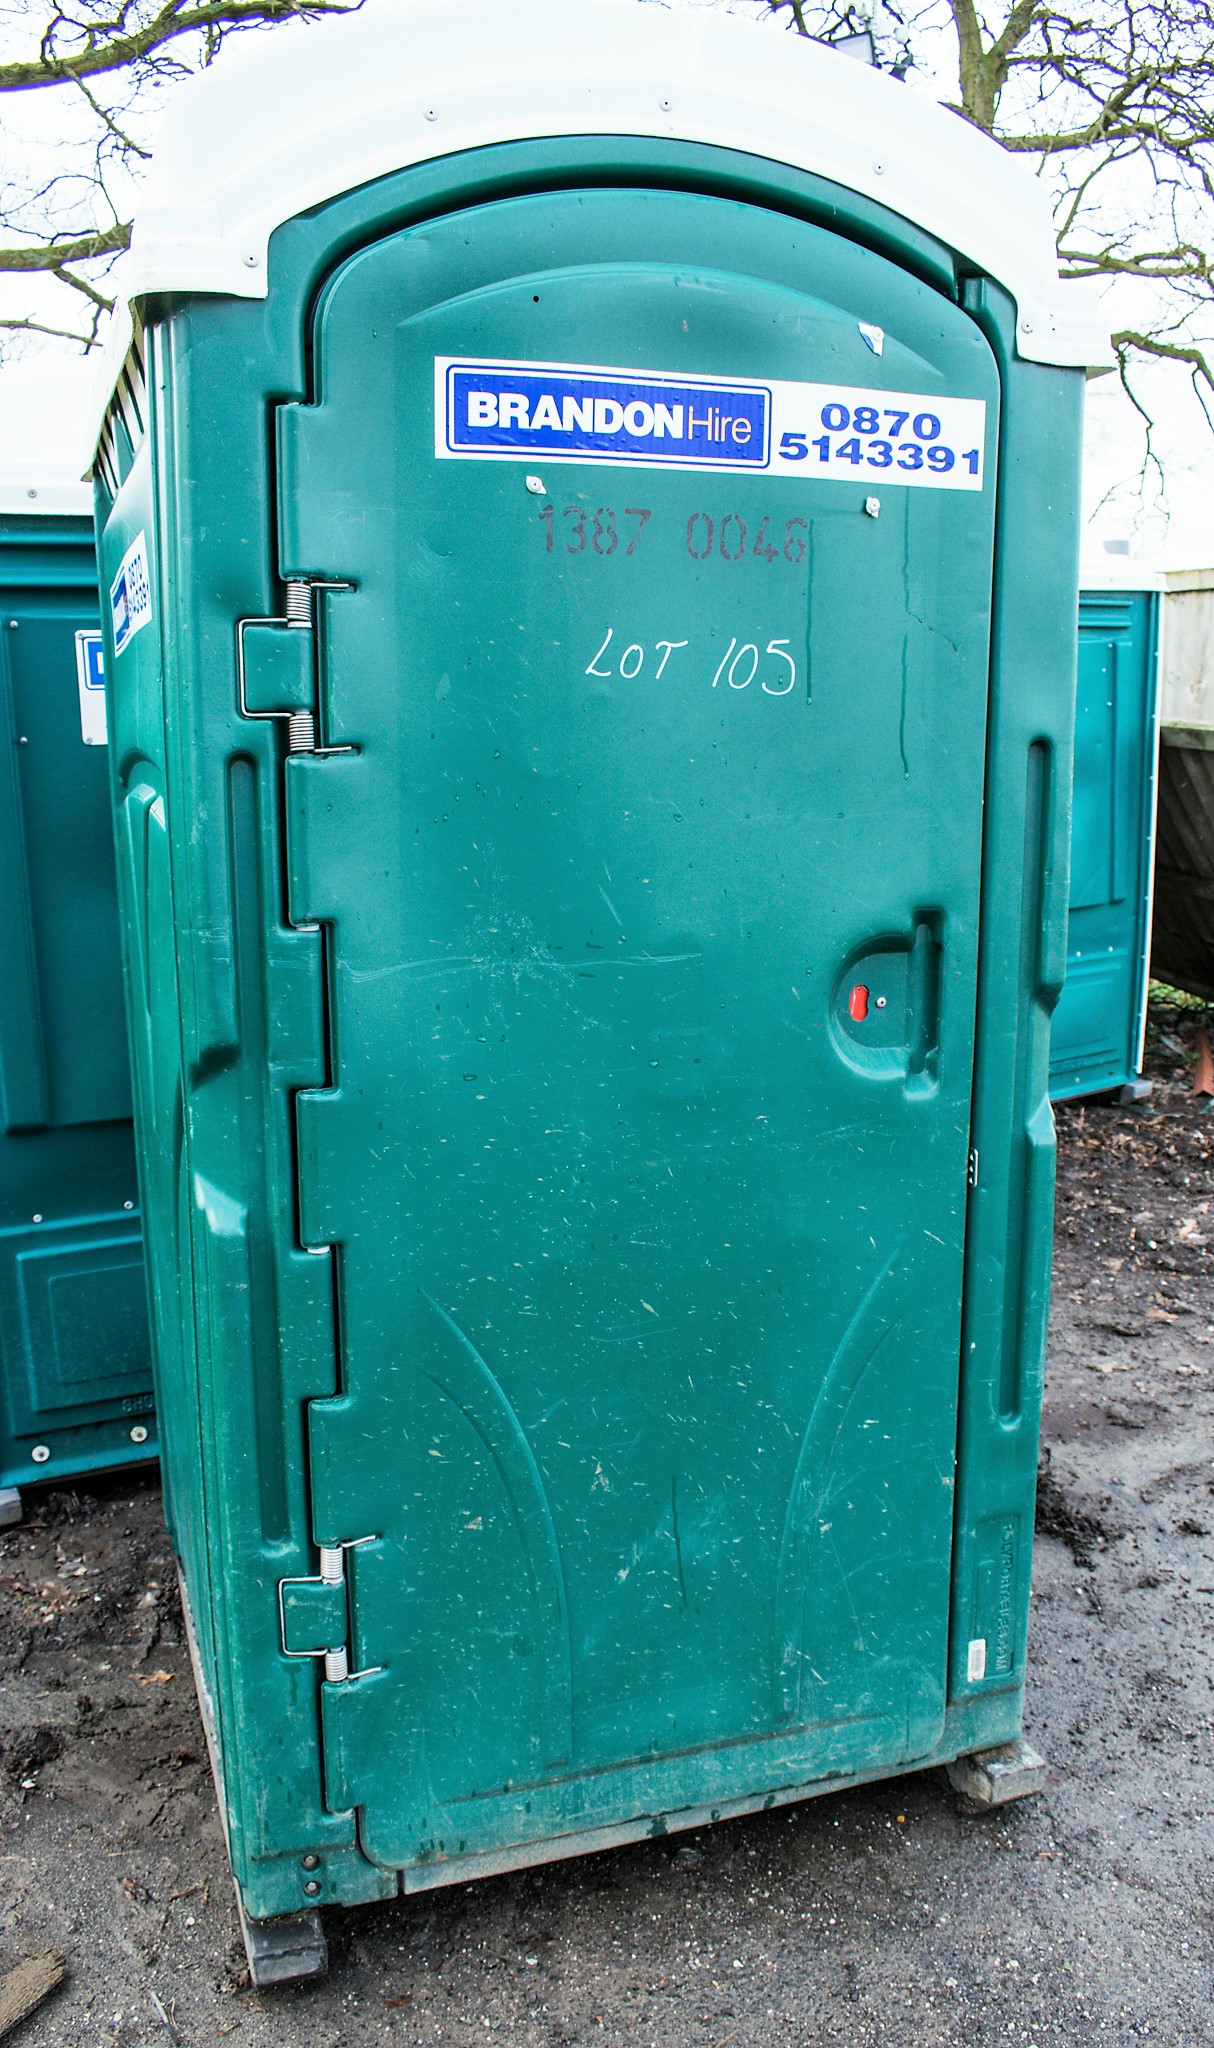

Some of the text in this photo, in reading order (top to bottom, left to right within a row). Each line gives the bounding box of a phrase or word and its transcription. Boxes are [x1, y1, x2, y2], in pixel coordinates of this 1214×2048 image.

[820, 403, 941, 440] 0870
[778, 432, 980, 475] 5143391
[538, 504, 810, 563] 1387 0046
[585, 628, 797, 697] LOT 105
